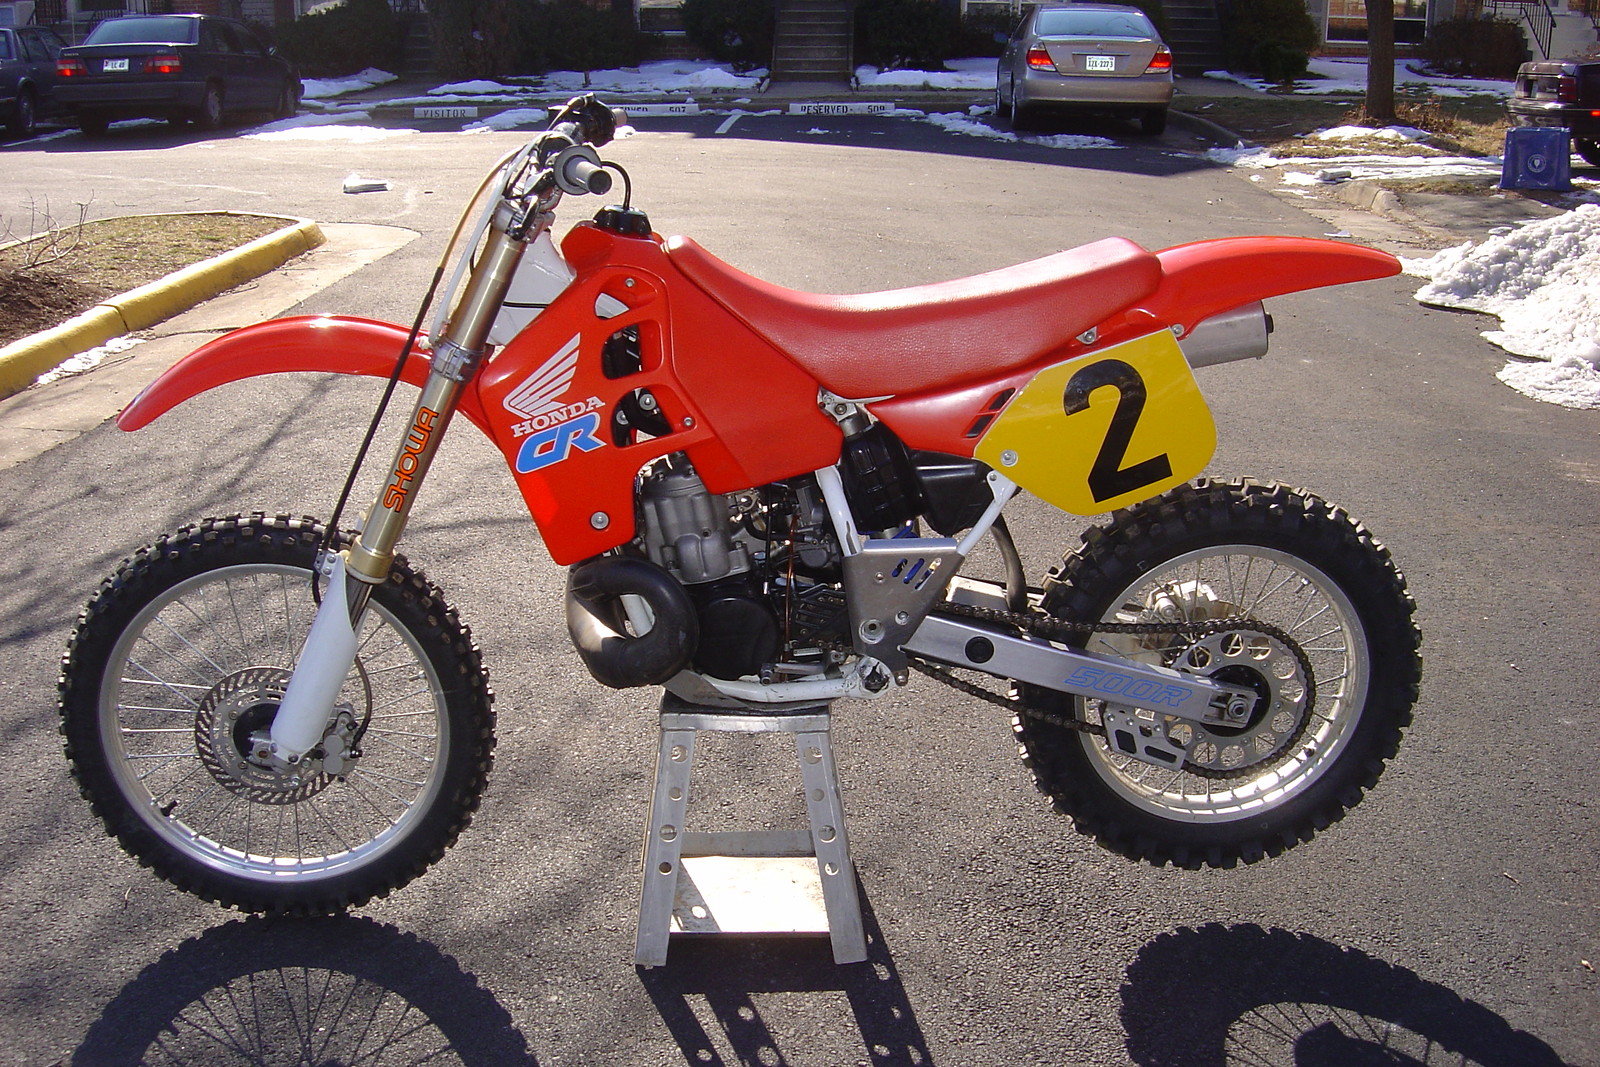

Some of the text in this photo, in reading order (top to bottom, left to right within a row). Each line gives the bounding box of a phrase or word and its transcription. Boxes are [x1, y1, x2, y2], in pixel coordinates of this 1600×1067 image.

[423, 109, 466, 118] VISITOR
[510, 396, 606, 438] HONDA
[515, 411, 608, 474] CR
[1063, 358, 1173, 504] 2
[383, 406, 440, 513] SHOWA
[1064, 665, 1193, 707] 500R
